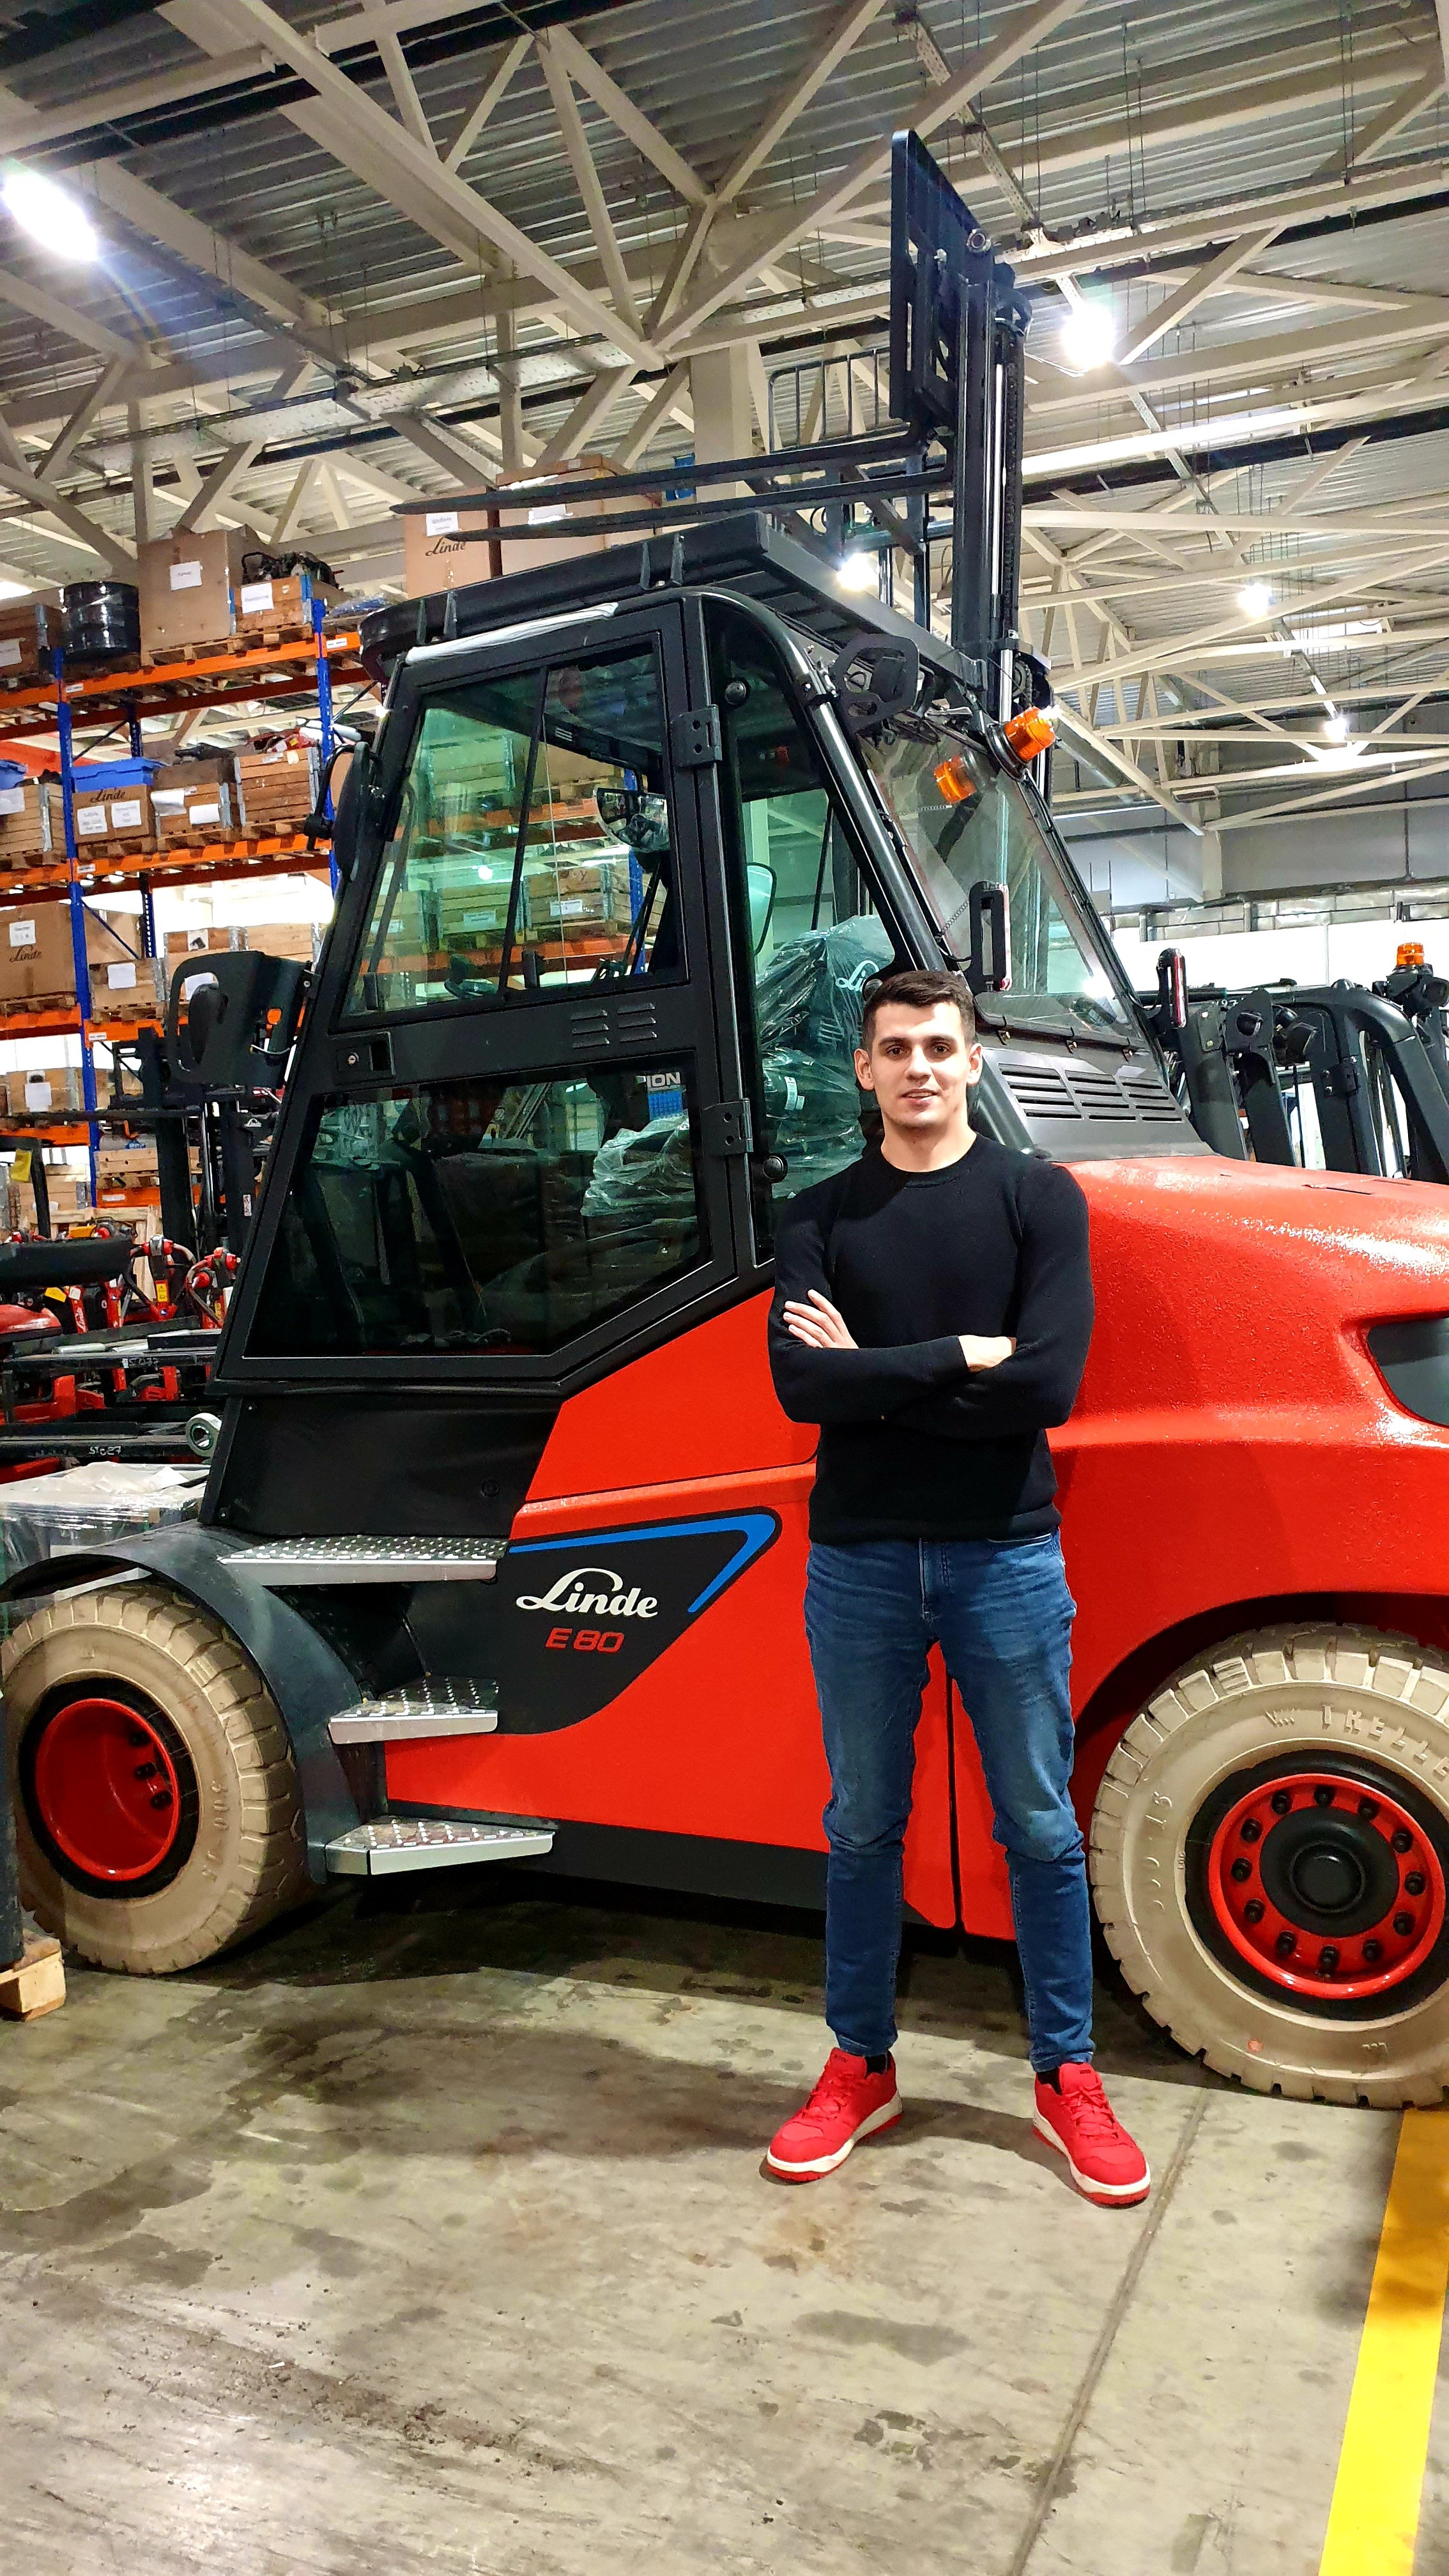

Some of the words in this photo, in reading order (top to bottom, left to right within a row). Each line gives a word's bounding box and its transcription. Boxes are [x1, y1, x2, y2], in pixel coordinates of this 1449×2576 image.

[516, 1567, 659, 1618] Linde
[545, 1627, 572, 1649] E
[573, 1629, 625, 1653] 80
